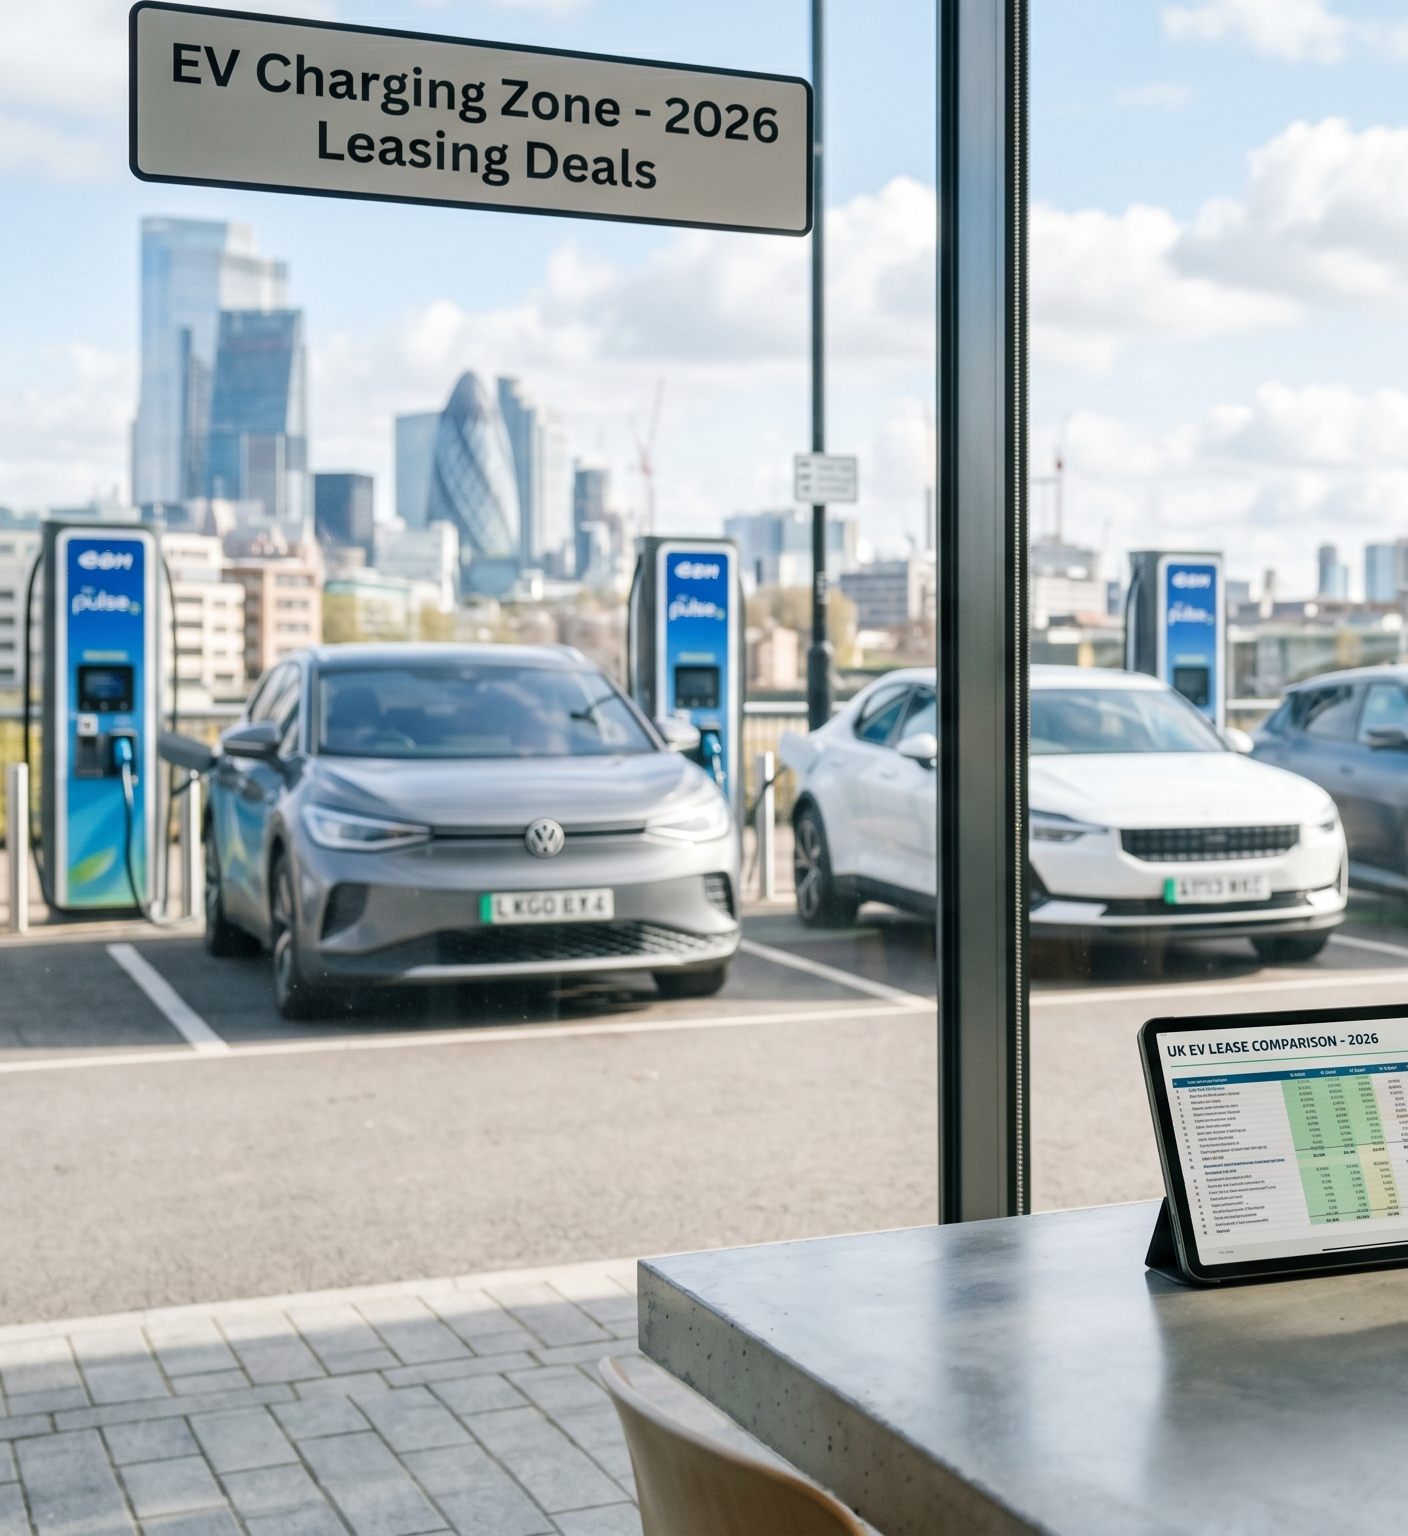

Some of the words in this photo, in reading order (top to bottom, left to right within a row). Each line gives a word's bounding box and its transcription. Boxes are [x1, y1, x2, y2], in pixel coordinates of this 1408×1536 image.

[173, 42, 241, 87] EV
[256, 53, 487, 124] Charging
[500, 78, 621, 127] Zone
[635, 108, 651, 117] -
[665, 97, 779, 143] 2026
[318, 120, 510, 187] Leasing
[526, 140, 657, 189] Deals
[1167, 1044, 1187, 1057] UK
[1189, 1043, 1205, 1056] EV
[1208, 1041, 1249, 1055] LEASE
[1251, 1035, 1338, 1052] COMPARISON
[1348, 1032, 1379, 1046] 2026
